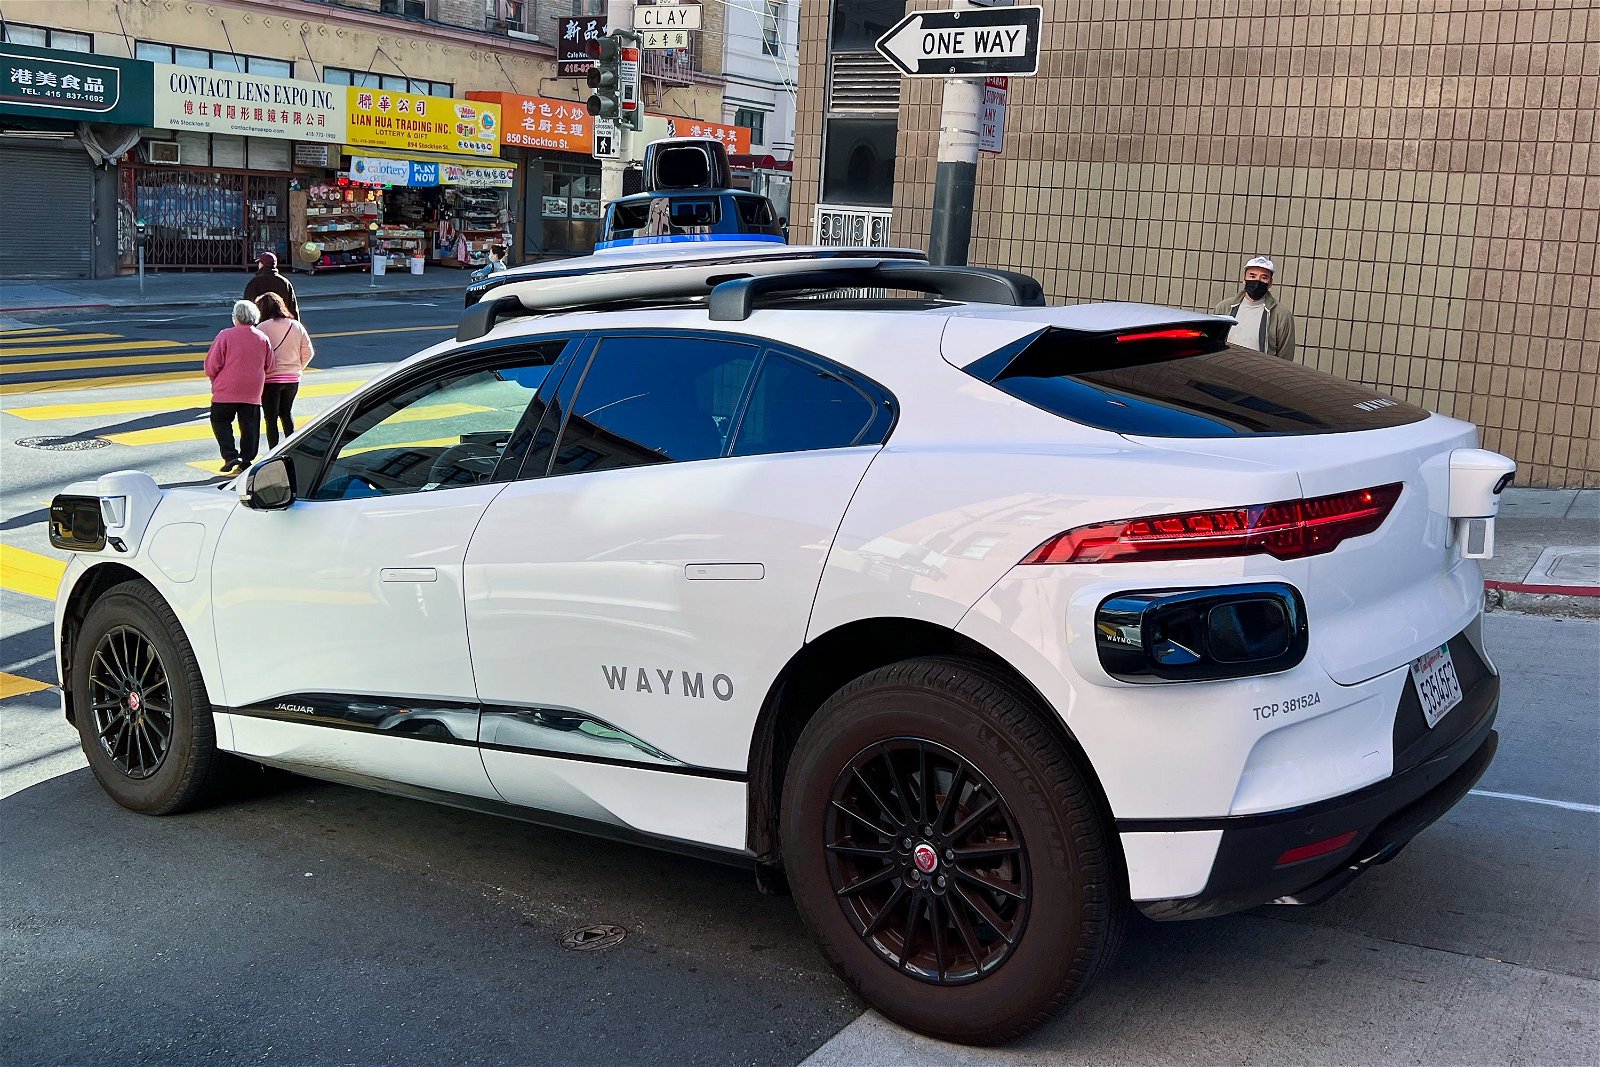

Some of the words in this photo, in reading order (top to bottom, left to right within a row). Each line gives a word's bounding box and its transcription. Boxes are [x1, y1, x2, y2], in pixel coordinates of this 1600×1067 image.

[644, 10, 687, 25] CLAY
[563, 20, 608, 43] 新品
[922, 32, 965, 55] ONE
[974, 29, 1020, 54] WAY
[10, 68, 104, 93] 港美食品
[21, 87, 41, 96] TEL:
[45, 90, 61, 98] 415
[170, 73, 232, 98] CONTACT
[237, 81, 270, 103] LENS
[274, 84, 308, 107] EXPO
[312, 89, 335, 110] INC.
[358, 93, 426, 116] 聯華公司
[522, 100, 584, 120] 特色小炒
[984, 108, 996, 121] ANY
[181, 119, 205, 127] Stockton
[351, 114, 371, 126] LIAN
[375, 116, 392, 128] HUA
[396, 118, 432, 133] TRADING
[435, 123, 451, 134] INC.
[982, 123, 996, 137] TIME
[376, 129, 405, 138] LOTTERY
[506, 133, 521, 143] 850
[522, 135, 558, 147] Stockton
[559, 139, 569, 149] St.
[418, 142, 442, 150] Stockton
[414, 163, 435, 174] PLAY
[415, 173, 435, 182] NOW
[1106, 634, 1132, 645] WAYMO
[601, 665, 734, 702] WAYMO
[275, 703, 314, 715] JAGUAR
[1253, 703, 1279, 720] TCP
[1282, 691, 1321, 714] 38152A
